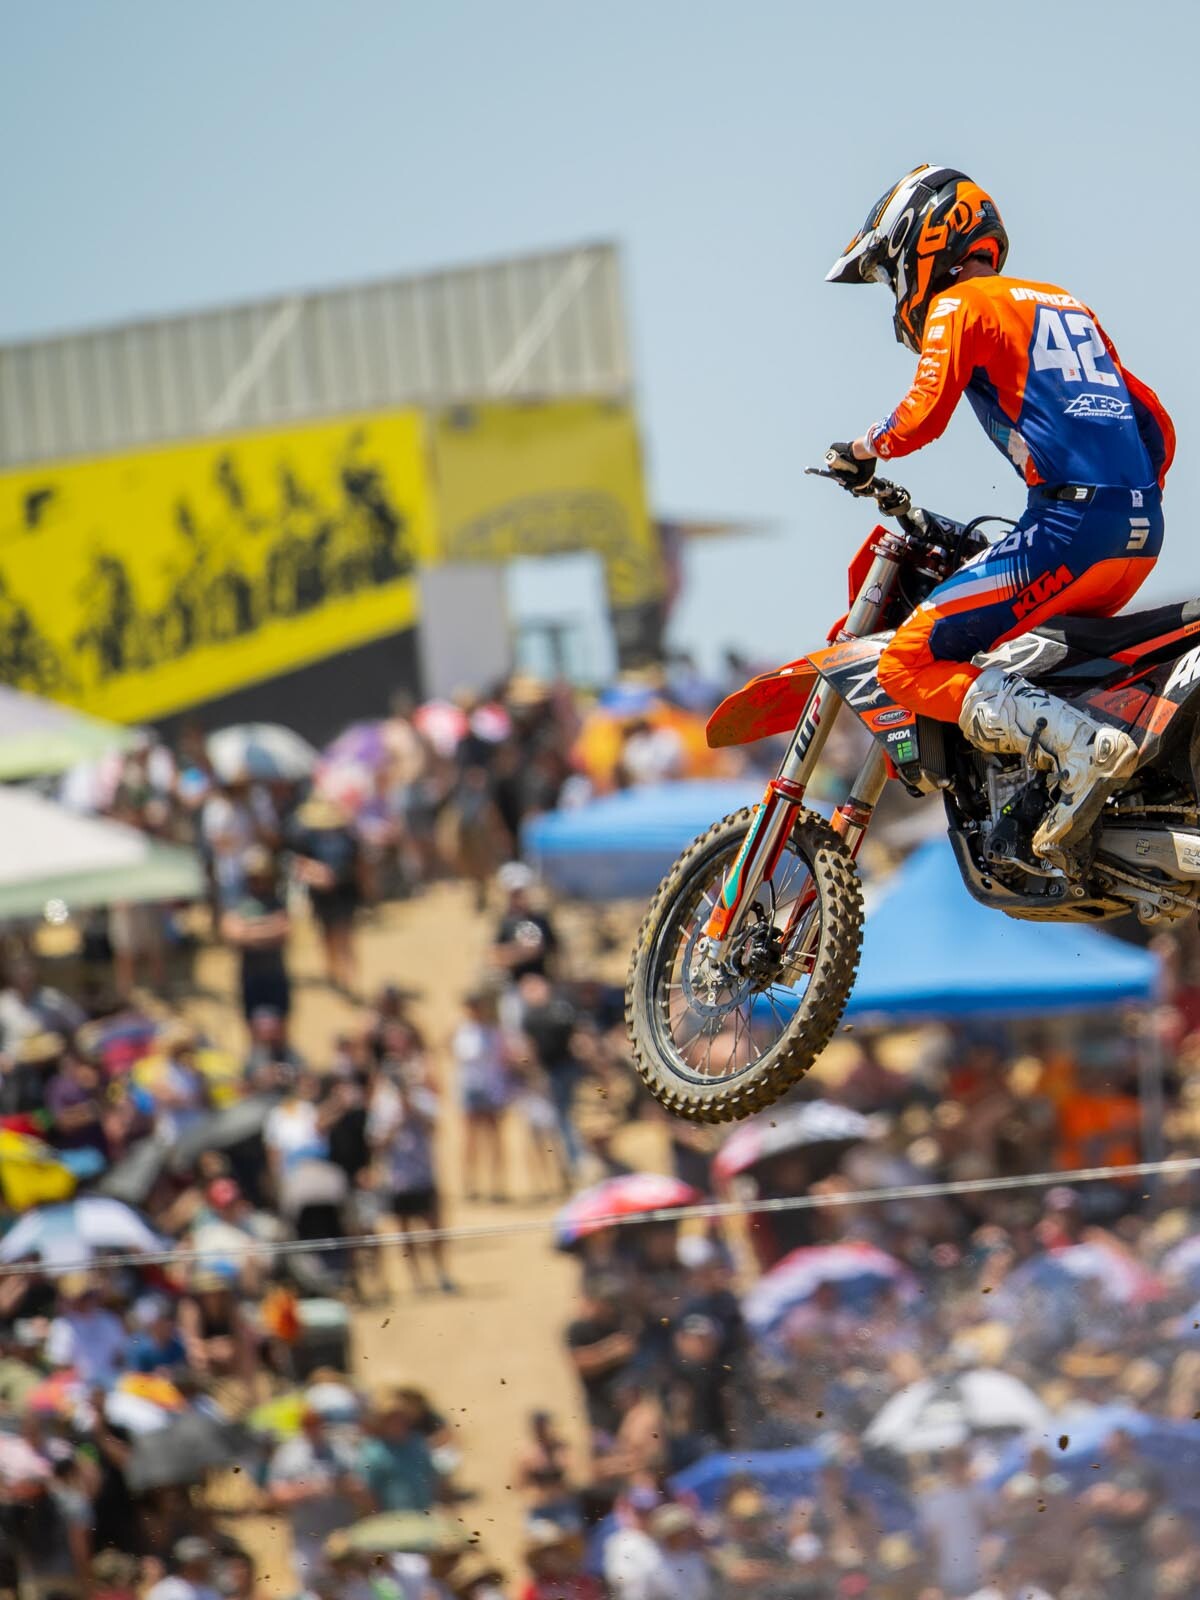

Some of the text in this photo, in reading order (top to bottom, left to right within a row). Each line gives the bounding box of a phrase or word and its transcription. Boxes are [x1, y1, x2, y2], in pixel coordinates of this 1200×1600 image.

[1032, 308, 1120, 387] 42
[1011, 564, 1074, 620] KTM
[887, 729, 911, 742] SKDA
